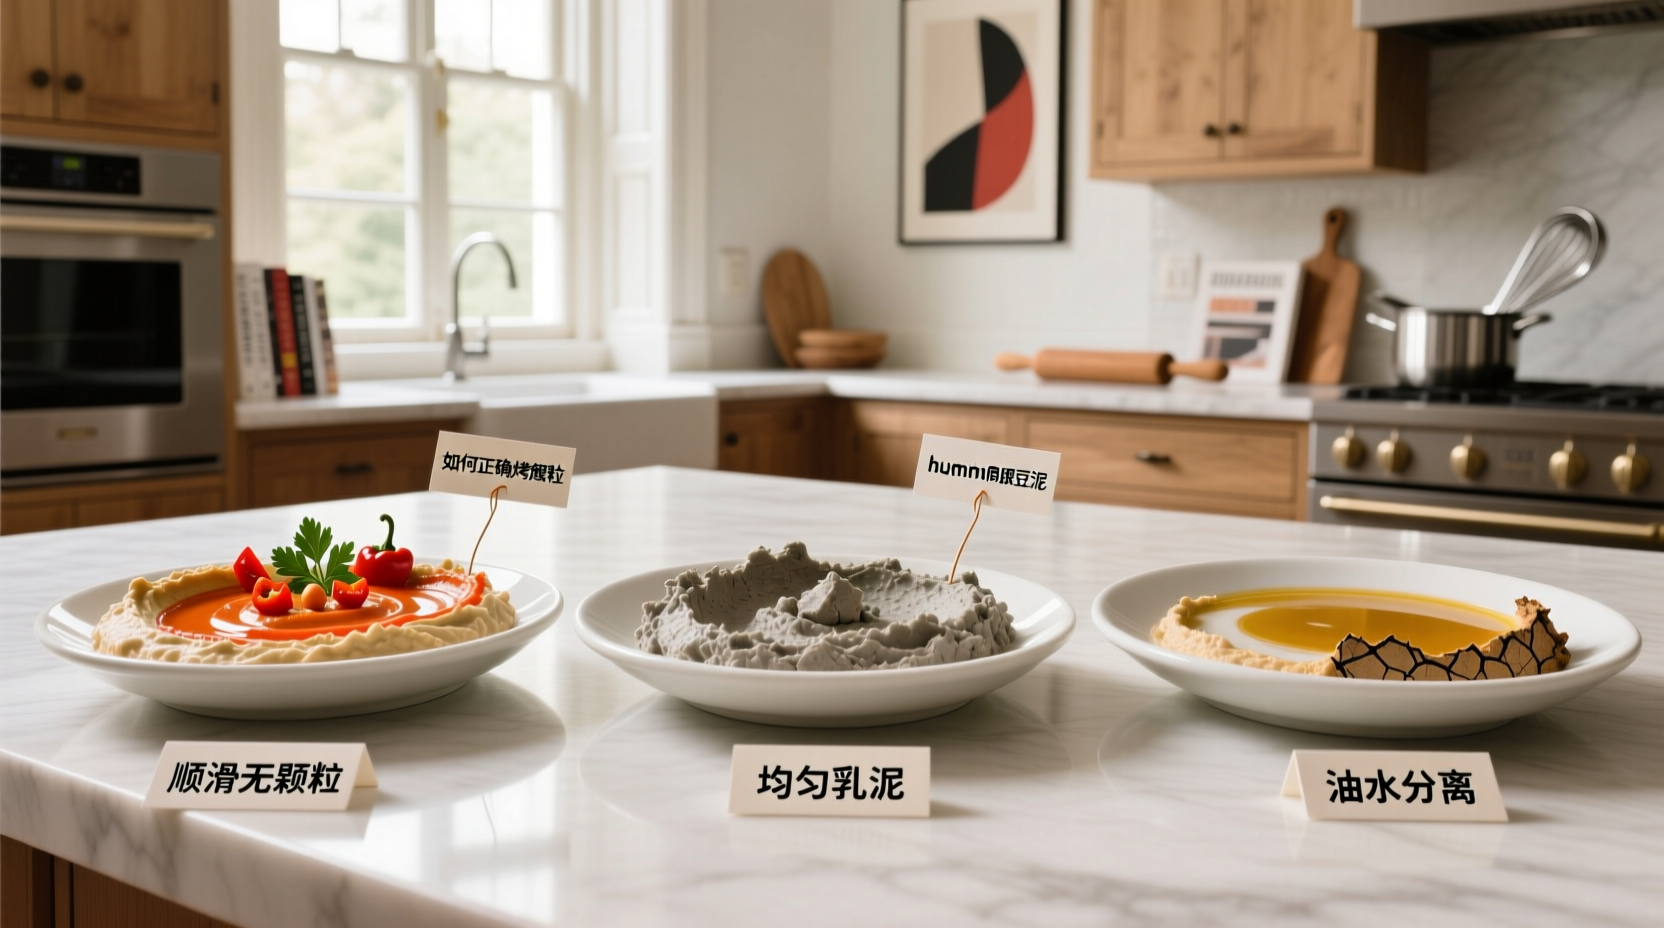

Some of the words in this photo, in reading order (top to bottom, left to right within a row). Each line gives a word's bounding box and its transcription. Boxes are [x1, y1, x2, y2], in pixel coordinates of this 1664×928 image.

[166, 761, 344, 794] 顺滑无颗粒
[756, 765, 905, 801] 均匀乳泥
[1326, 769, 1476, 805] 油水分离
